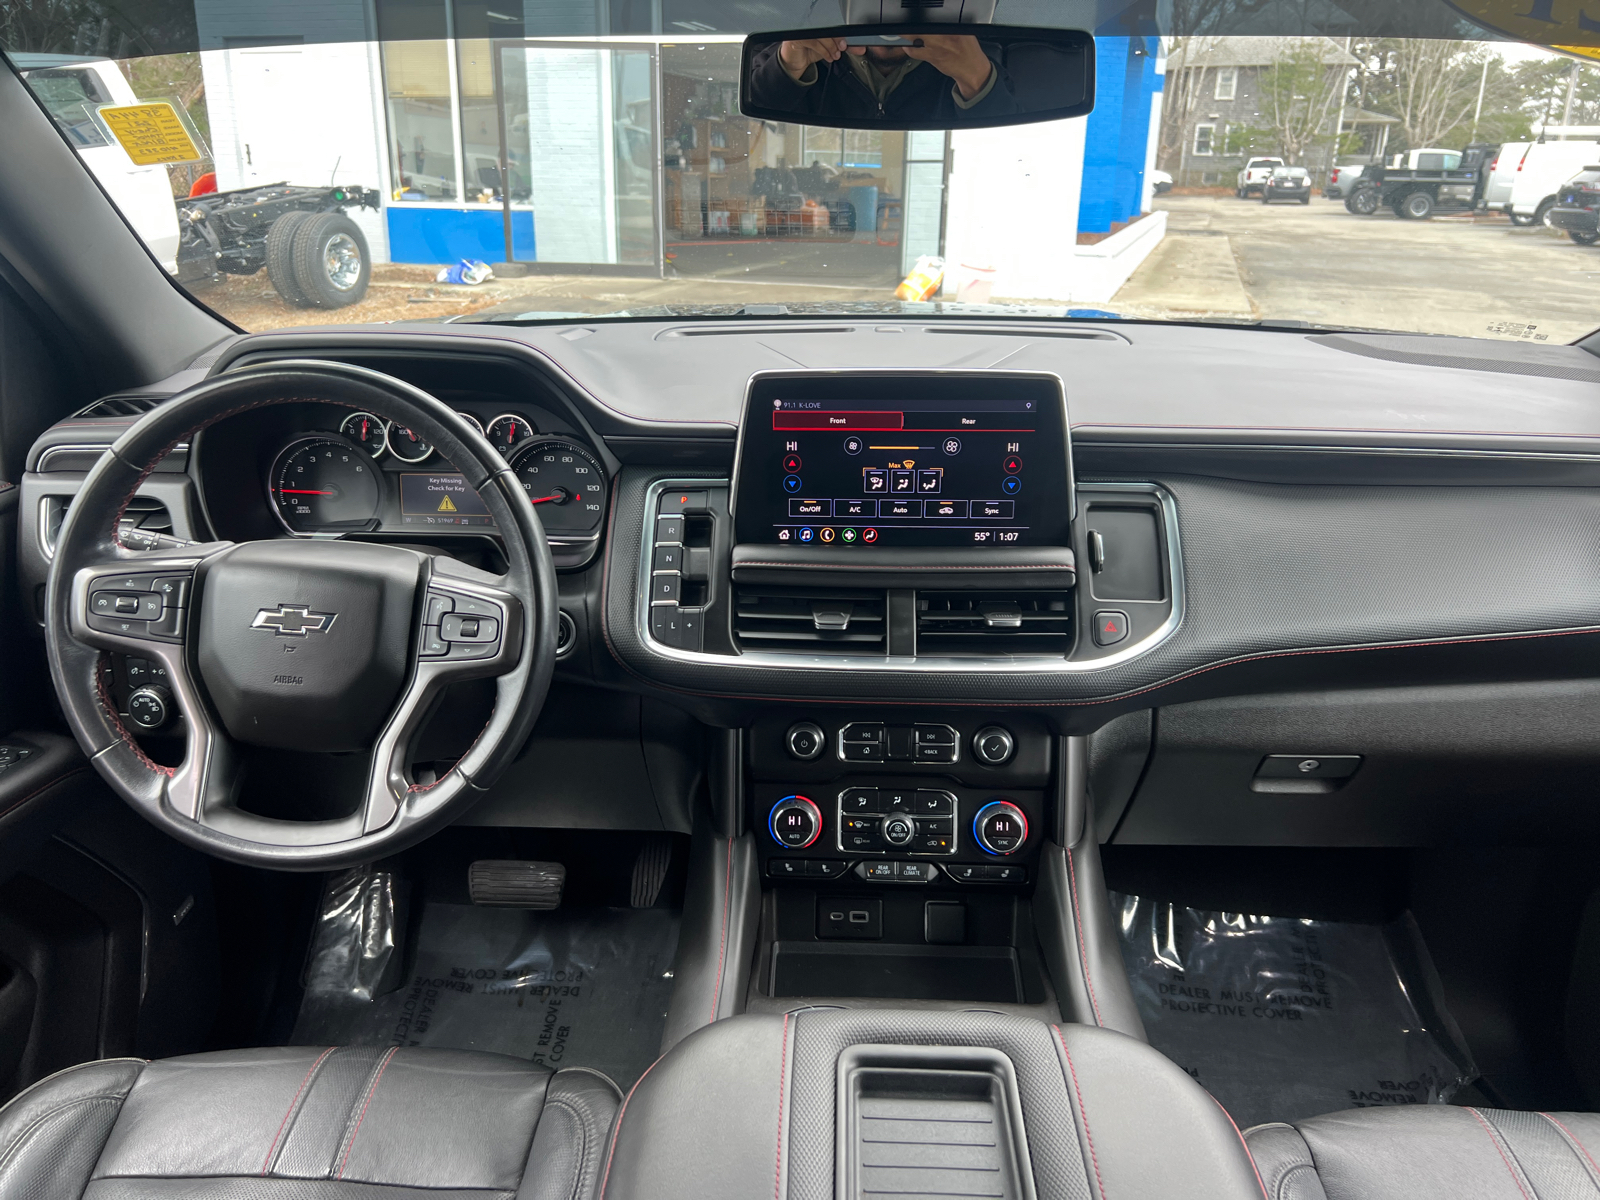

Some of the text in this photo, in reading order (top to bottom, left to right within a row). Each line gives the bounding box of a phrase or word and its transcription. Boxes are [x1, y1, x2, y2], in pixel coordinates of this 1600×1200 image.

[829, 417, 847, 425] Front
[786, 441, 798, 451] HI
[1007, 442, 1019, 452] HI
[429, 477, 440, 485] Key
[680, 496, 688, 504] P
[799, 505, 822, 514] On/Off
[849, 505, 861, 514] A/C
[893, 506, 908, 514] Auto
[984, 507, 999, 516] Sync
[999, 532, 1019, 542] 1:07
[663, 585, 670, 593] D
[670, 621, 676, 629] L
[273, 675, 304, 685] AIRBAG
[788, 815, 801, 826] HI
[996, 821, 1009, 832] HI
[450, 967, 497, 980] COVER
[529, 985, 581, 997] DEALER
[1158, 982, 1333, 1010] DEALER MUST REMOVE
[413, 988, 438, 1033] DEALER
[1160, 998, 1303, 1021] PROTECTIVE COVER
[390, 986, 421, 1047] PROTECTI
[537, 998, 562, 1047] REMOVE
[549, 1025, 571, 1063] COVER
[1347, 1090, 1417, 1104] REMOVE
